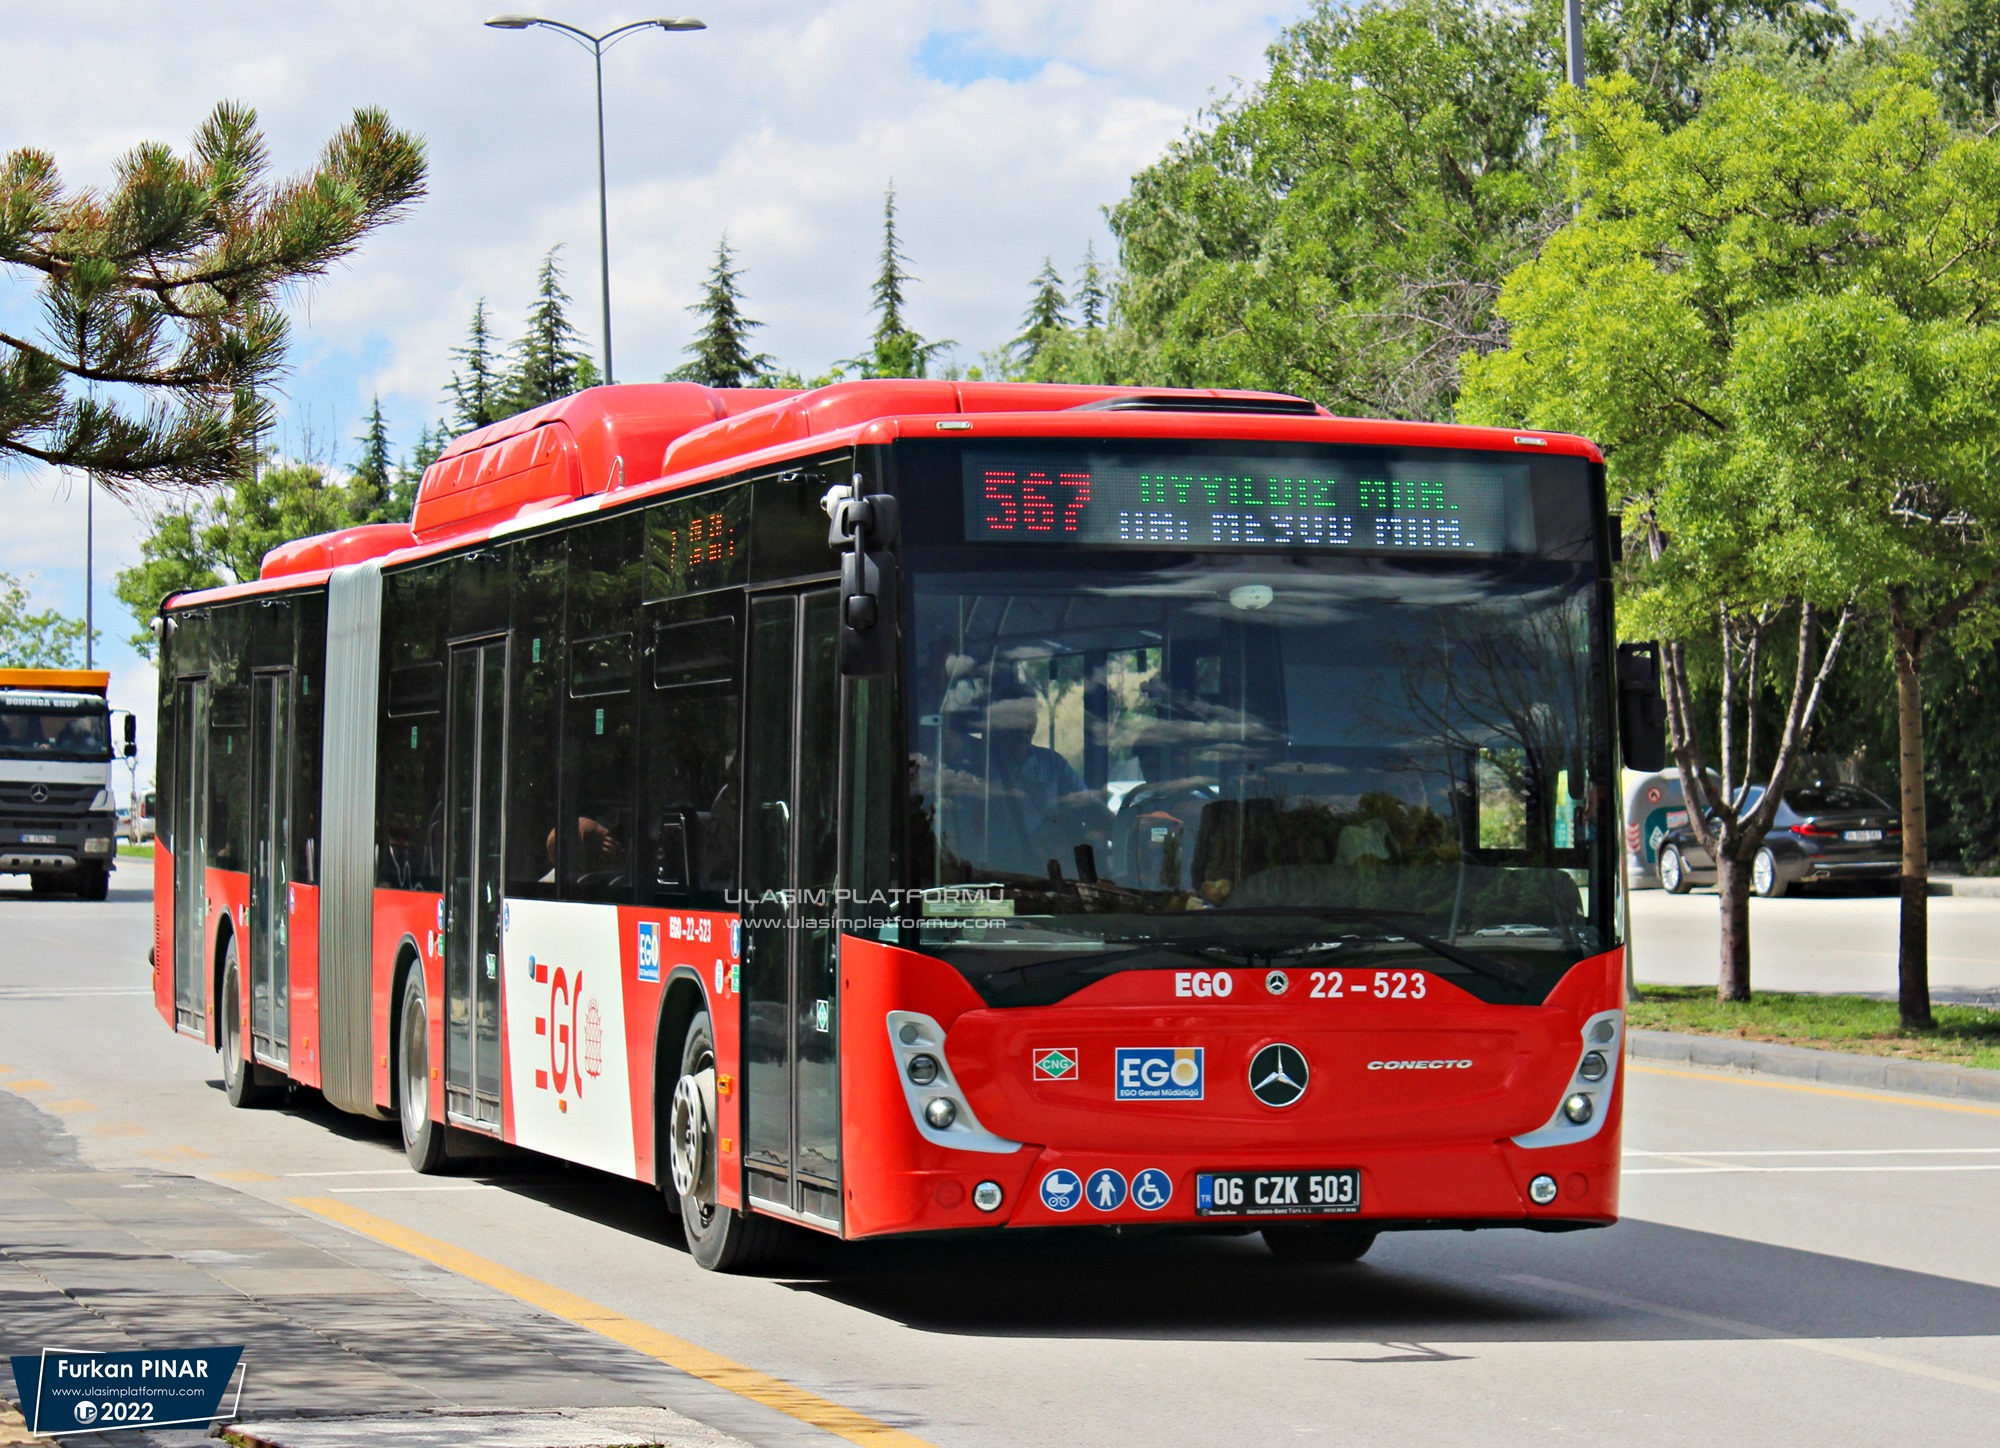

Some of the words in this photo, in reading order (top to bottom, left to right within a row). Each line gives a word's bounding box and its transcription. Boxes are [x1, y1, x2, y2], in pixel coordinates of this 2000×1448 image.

[986, 472, 1091, 531] 567
[640, 933, 659, 967] EGO
[1175, 971, 1233, 998] EGO
[1042, 1059, 1069, 1070] CNG
[1121, 1058, 1199, 1087] EGO
[1367, 1059, 1473, 1070] CONECTO
[1120, 1089, 1137, 1097] EGO
[1138, 1089, 1160, 1097] Genel
[1161, 1088, 1199, 1098] Müdürlüğü
[1201, 1194, 1212, 1203] TR
[1214, 1177, 1244, 1206] 06
[1255, 1176, 1299, 1205] CZK
[1309, 1175, 1353, 1204] 503
